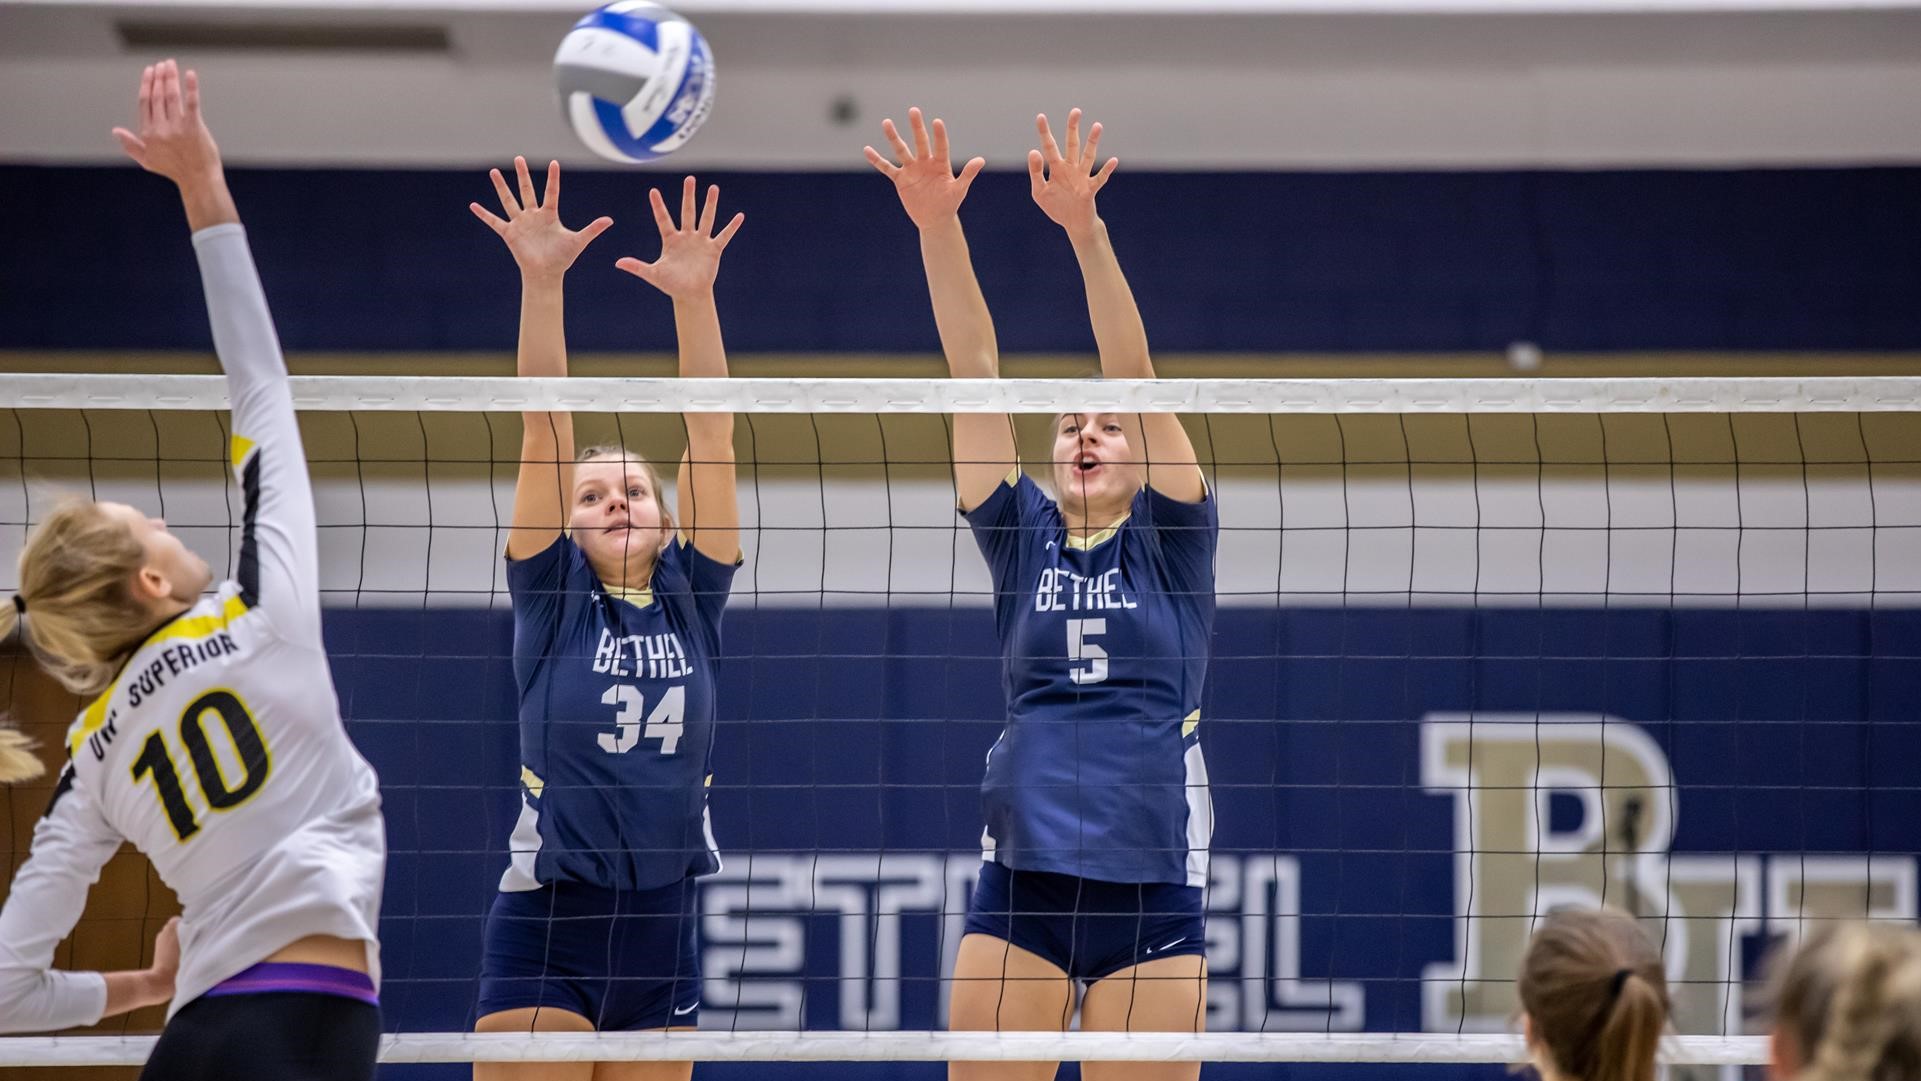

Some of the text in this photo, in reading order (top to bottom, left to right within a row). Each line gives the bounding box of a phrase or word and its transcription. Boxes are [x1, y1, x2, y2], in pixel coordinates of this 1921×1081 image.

[1035, 567, 1137, 612] BETHEL
[129, 633, 239, 708] SUPERIOR
[592, 626, 694, 679] BETHEL
[1066, 618, 1108, 685] 5
[597, 684, 686, 755] 34
[130, 687, 272, 843] 10
